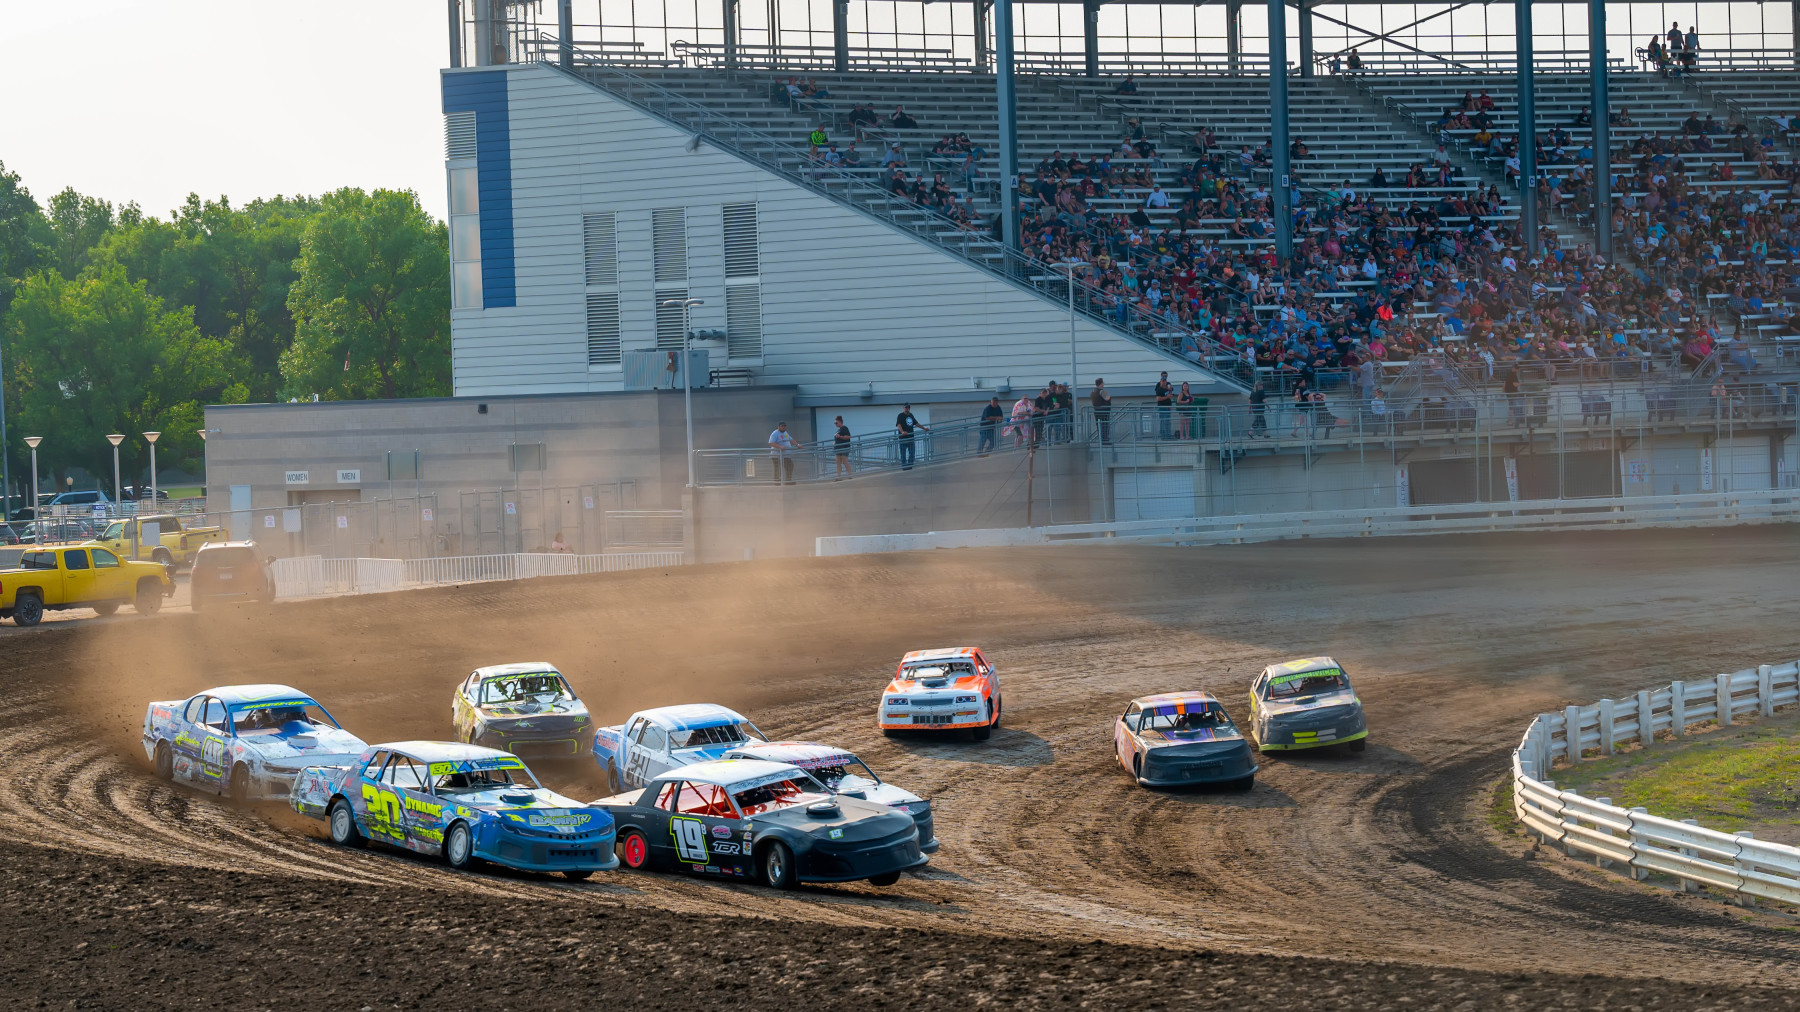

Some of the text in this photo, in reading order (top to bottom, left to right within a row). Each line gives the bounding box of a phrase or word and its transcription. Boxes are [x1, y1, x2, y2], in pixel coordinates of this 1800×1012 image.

[1011, 177, 1017, 185] A
[1283, 177, 1288, 185] B
[1529, 177, 1534, 185] C
[1777, 347, 1782, 355] C
[286, 473, 308, 481] WOMEN
[341, 472, 356, 480] MEN
[405, 796, 442, 818] DYNAMIC
[362, 783, 405, 840] 30
[672, 818, 707, 860] 19
[713, 840, 740, 855] TBR
